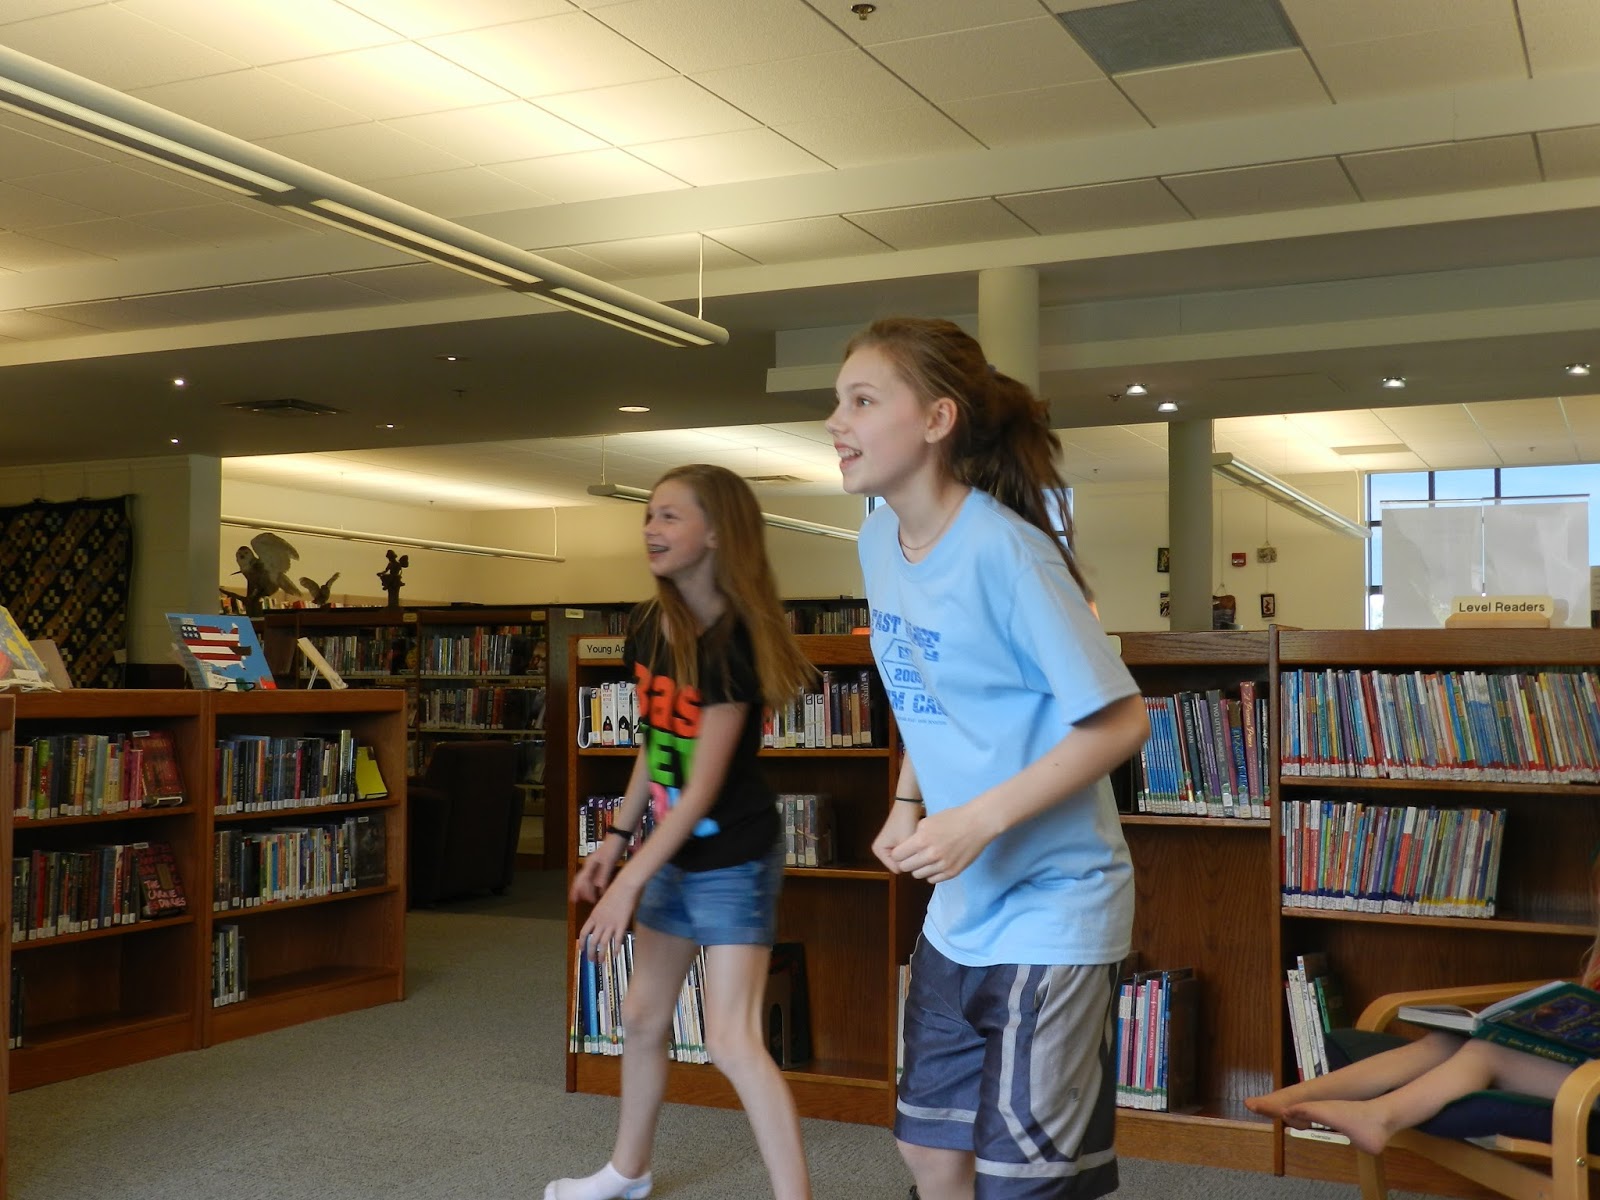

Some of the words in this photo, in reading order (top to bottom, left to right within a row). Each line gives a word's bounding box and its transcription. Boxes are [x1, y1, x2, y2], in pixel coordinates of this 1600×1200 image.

[1459, 602, 1491, 612] Level
[1495, 602, 1545, 612] Readers
[587, 644, 612, 655] Young
[1183, 702, 1191, 717] PAUL
[1212, 703, 1220, 717] TWO
[1186, 719, 1195, 744] BUNYAN
